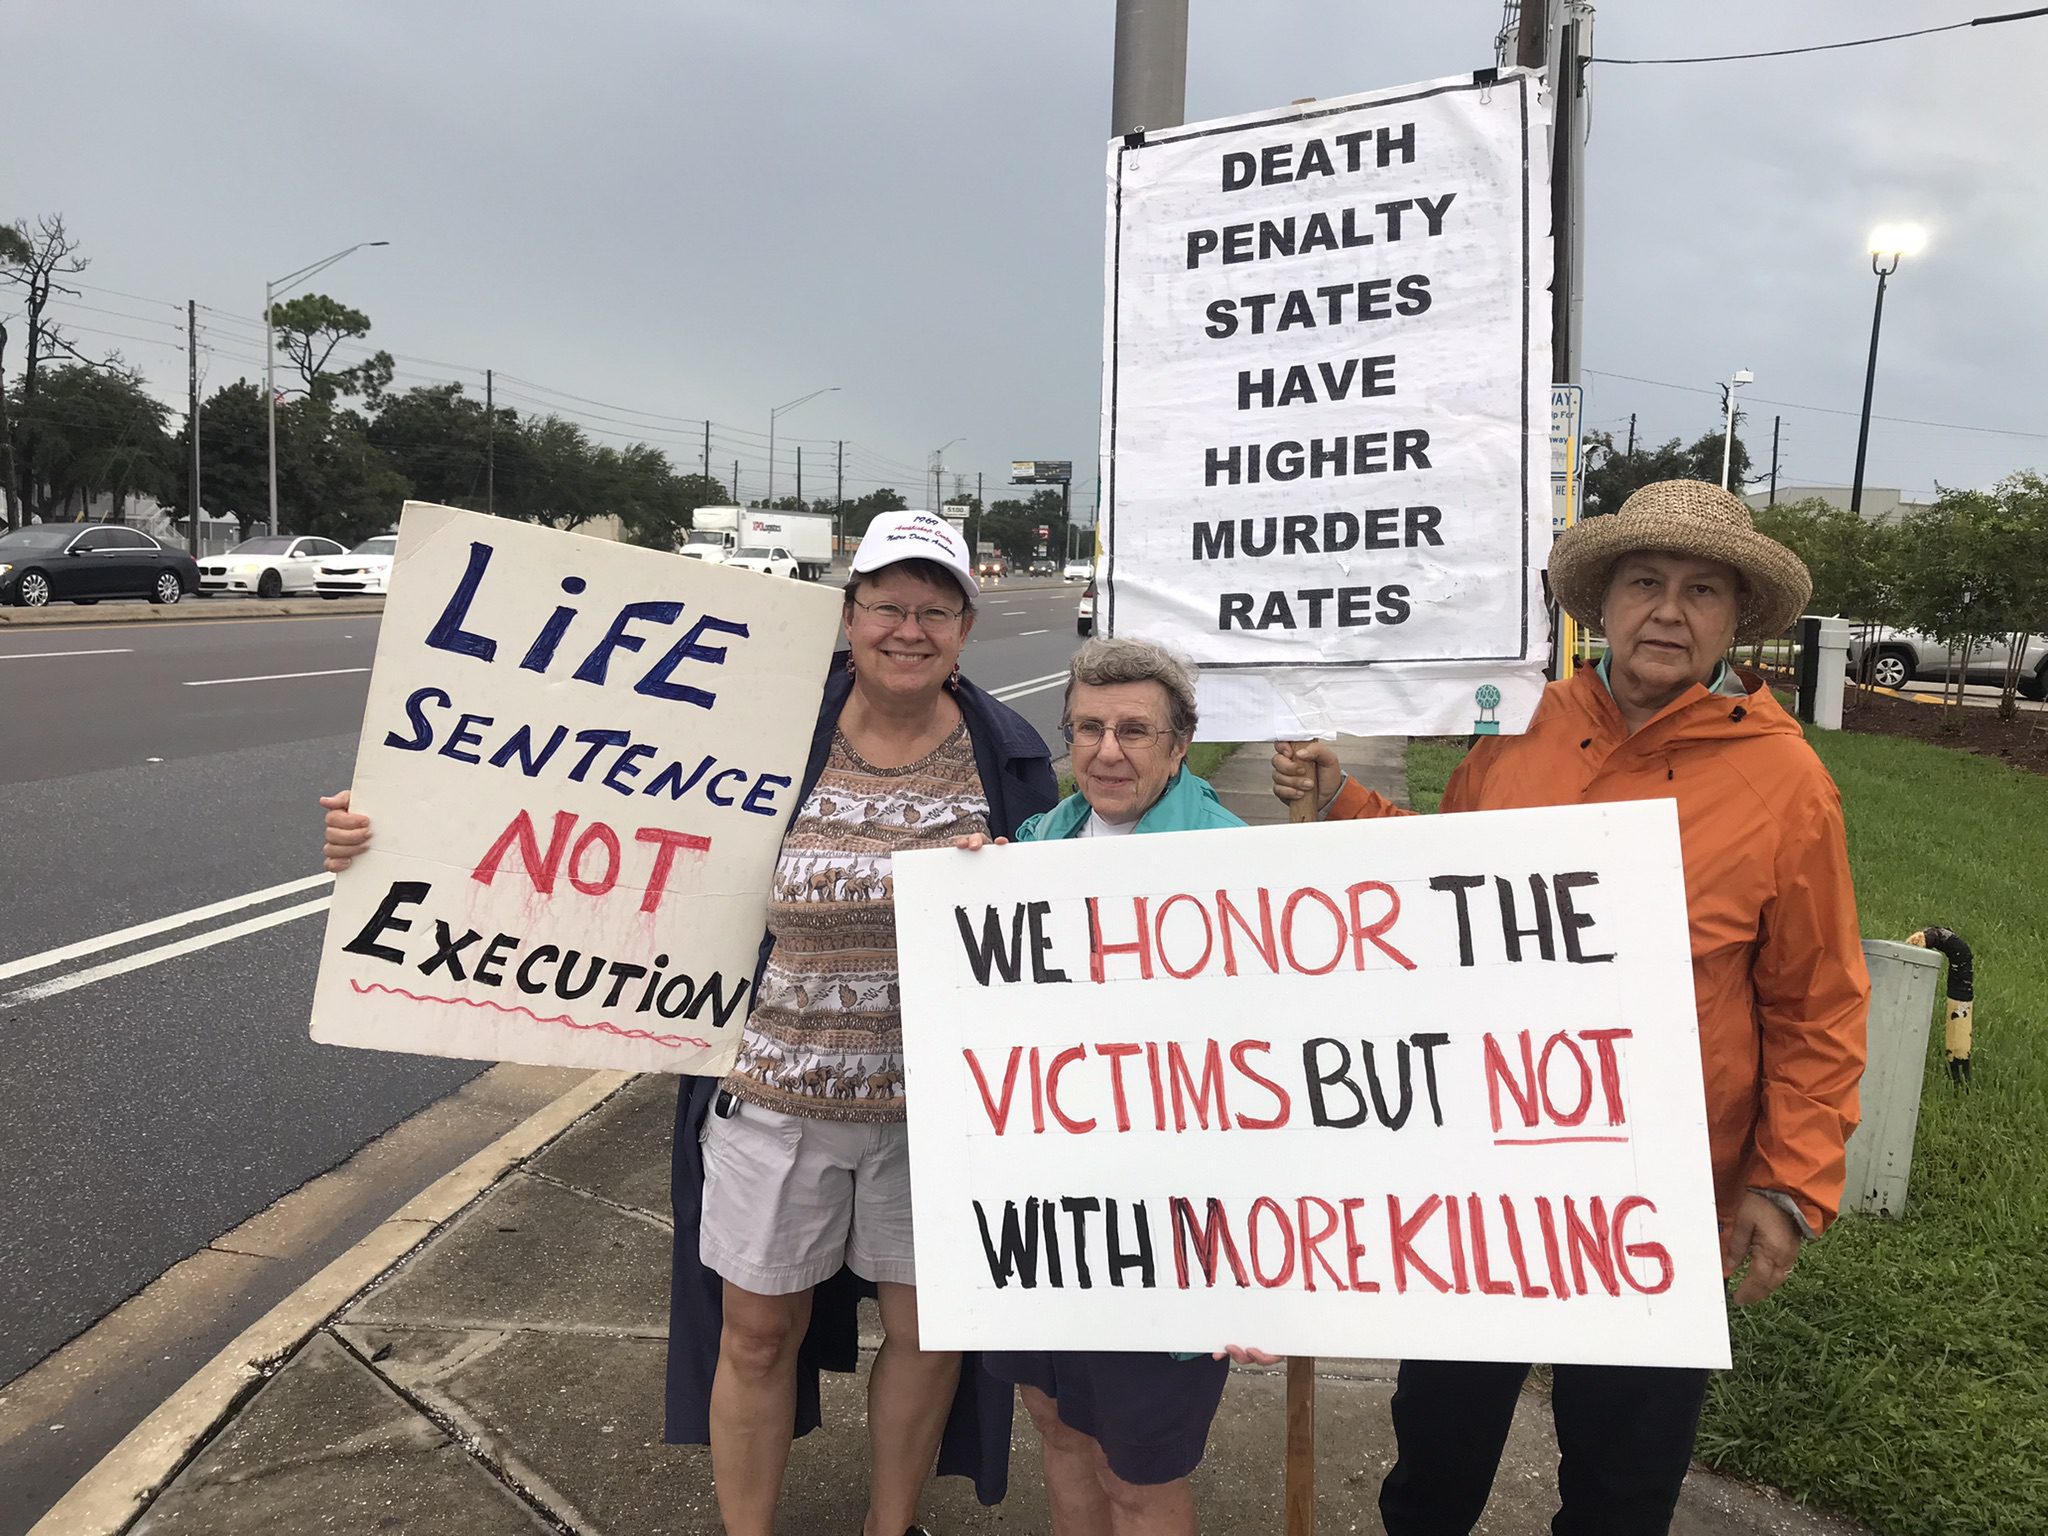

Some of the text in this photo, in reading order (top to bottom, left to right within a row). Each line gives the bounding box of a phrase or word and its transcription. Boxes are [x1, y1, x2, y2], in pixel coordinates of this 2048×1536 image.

[1221, 122, 1416, 193] DEATH
[1186, 192, 1458, 270] PENALTY
[1204, 274, 1433, 340] STATES
[1237, 354, 1397, 411] HAVE
[1204, 428, 1433, 488] HIGHER
[909, 532, 930, 542] Dame
[913, 515, 940, 526] 1969
[1191, 505, 1446, 562] MURDER
[1217, 584, 1412, 631] RATES
[383, 686, 792, 817] SENTENCE
[470, 808, 713, 914] NOT
[954, 871, 1616, 986] WE HONOR THE
[962, 1028, 1633, 1135] VICTIMS BUT NOT
[972, 1192, 1675, 1300] WITH MORE KILLING
